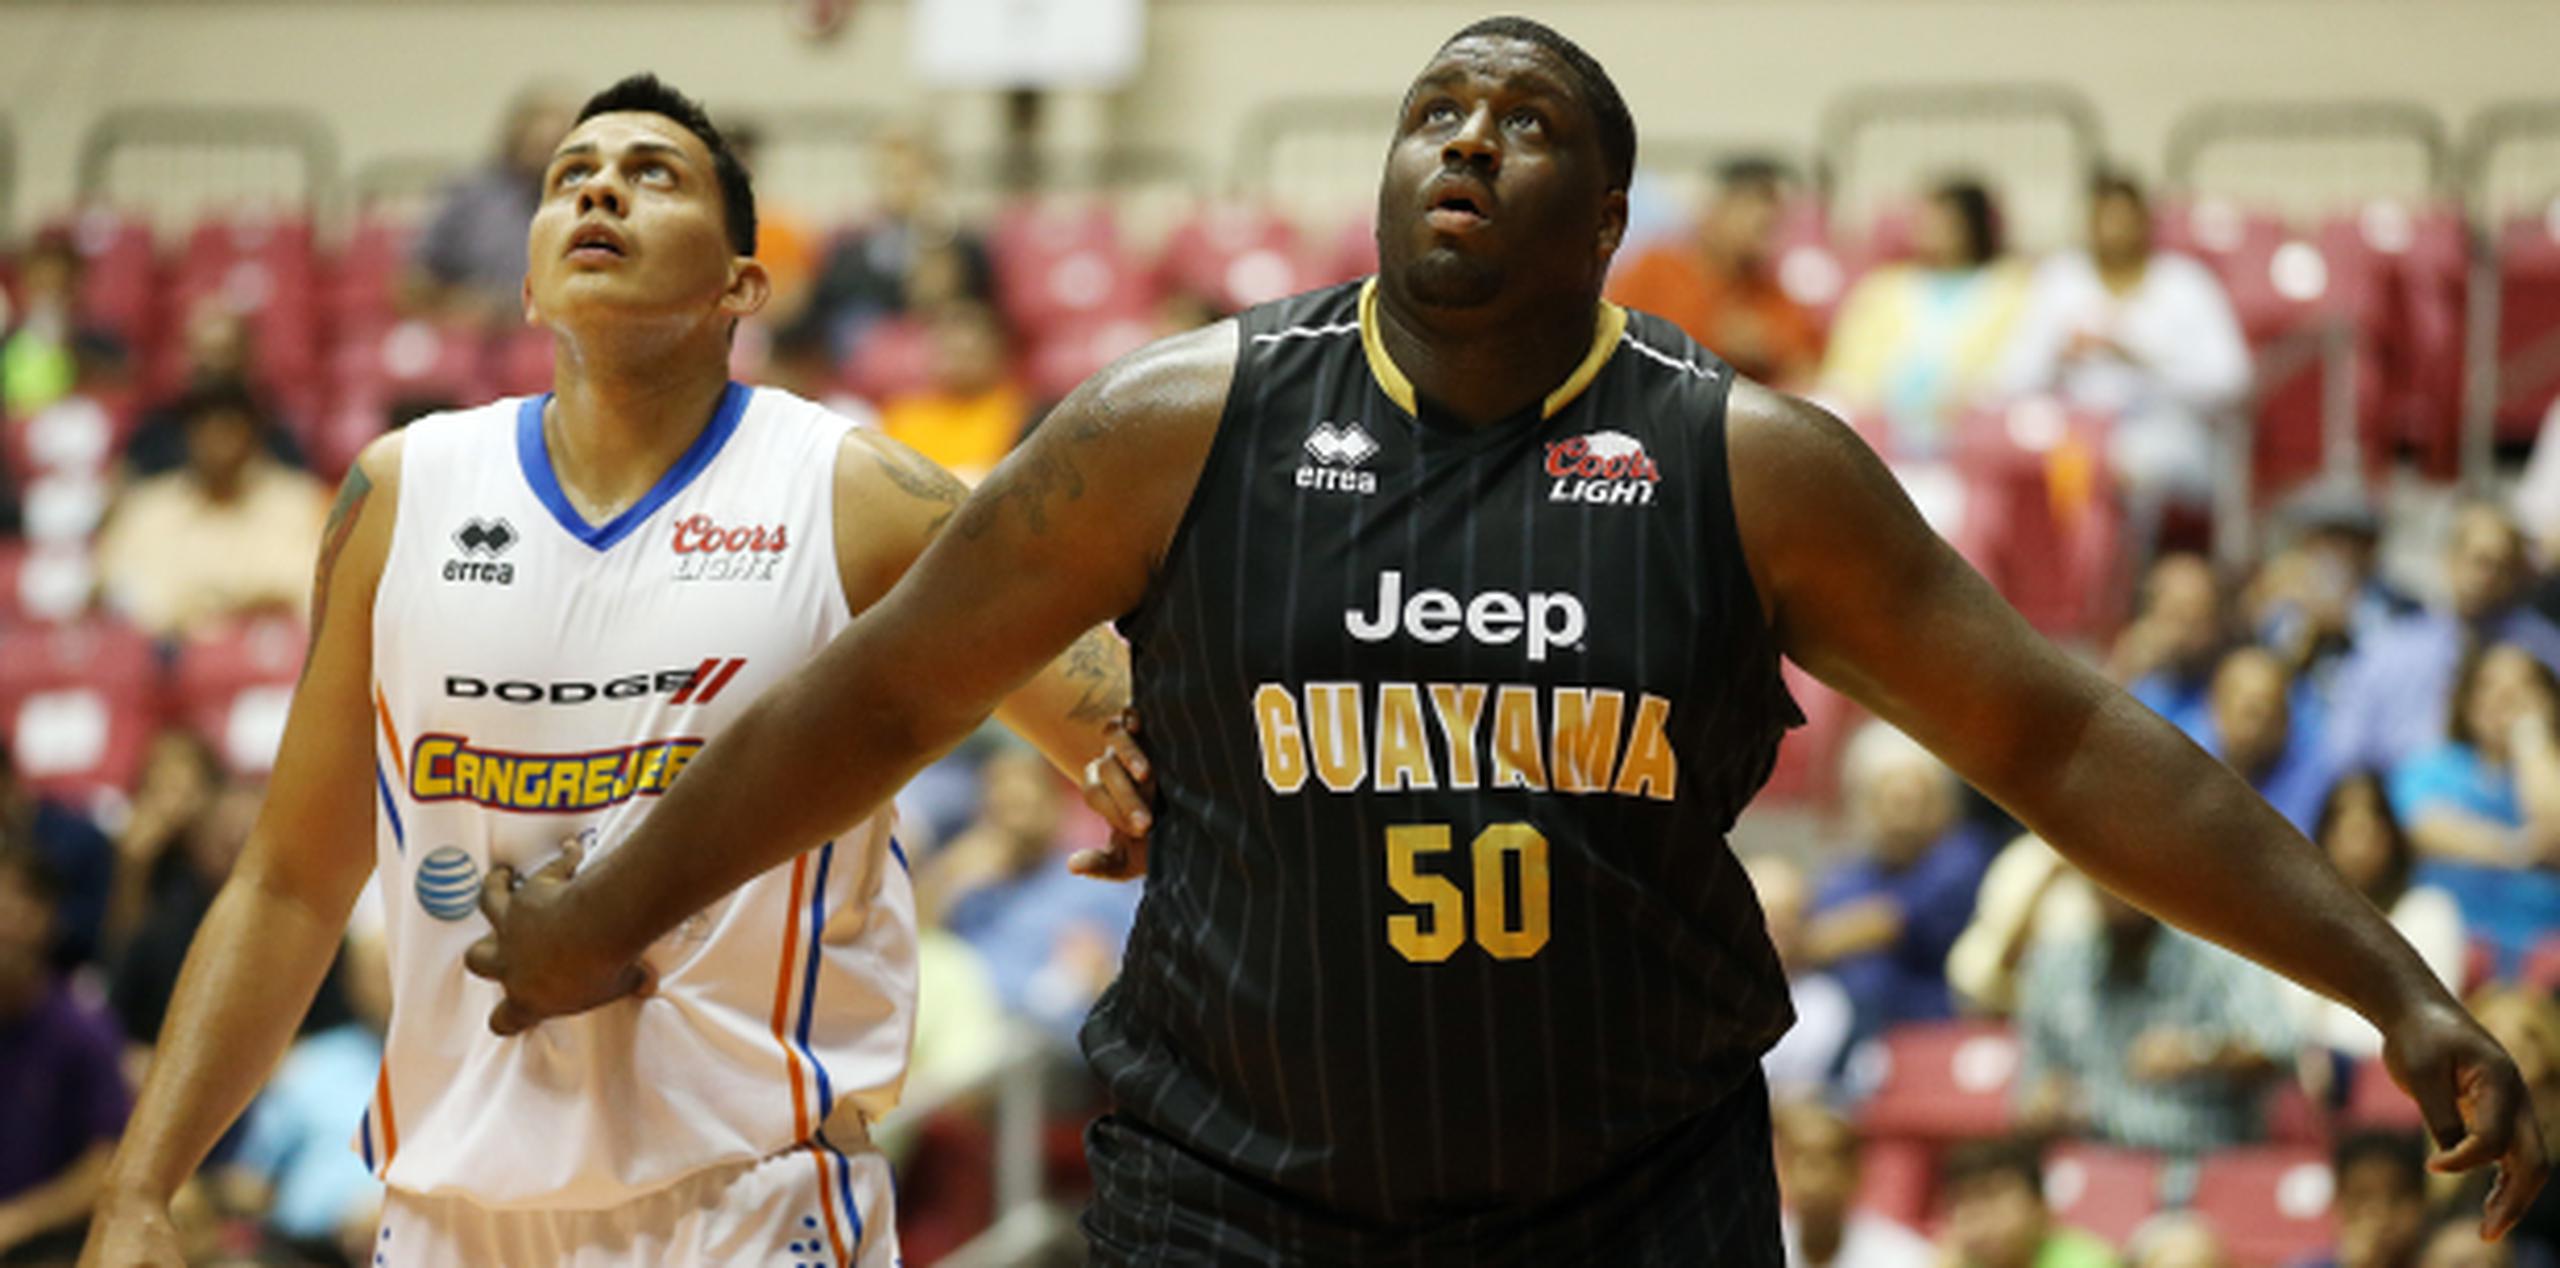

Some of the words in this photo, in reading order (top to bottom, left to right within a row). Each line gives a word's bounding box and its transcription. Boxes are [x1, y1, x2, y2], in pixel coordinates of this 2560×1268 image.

[1548, 478, 1655, 505] LIGHT
[671, 513, 789, 555] Coors
[671, 554, 783, 581] LIGHT
[1345, 571, 1587, 661] Jeep
[445, 669, 701, 704] DODGE
[1252, 681, 1678, 800] GUAYAMA
[1385, 821, 1551, 963] 50
